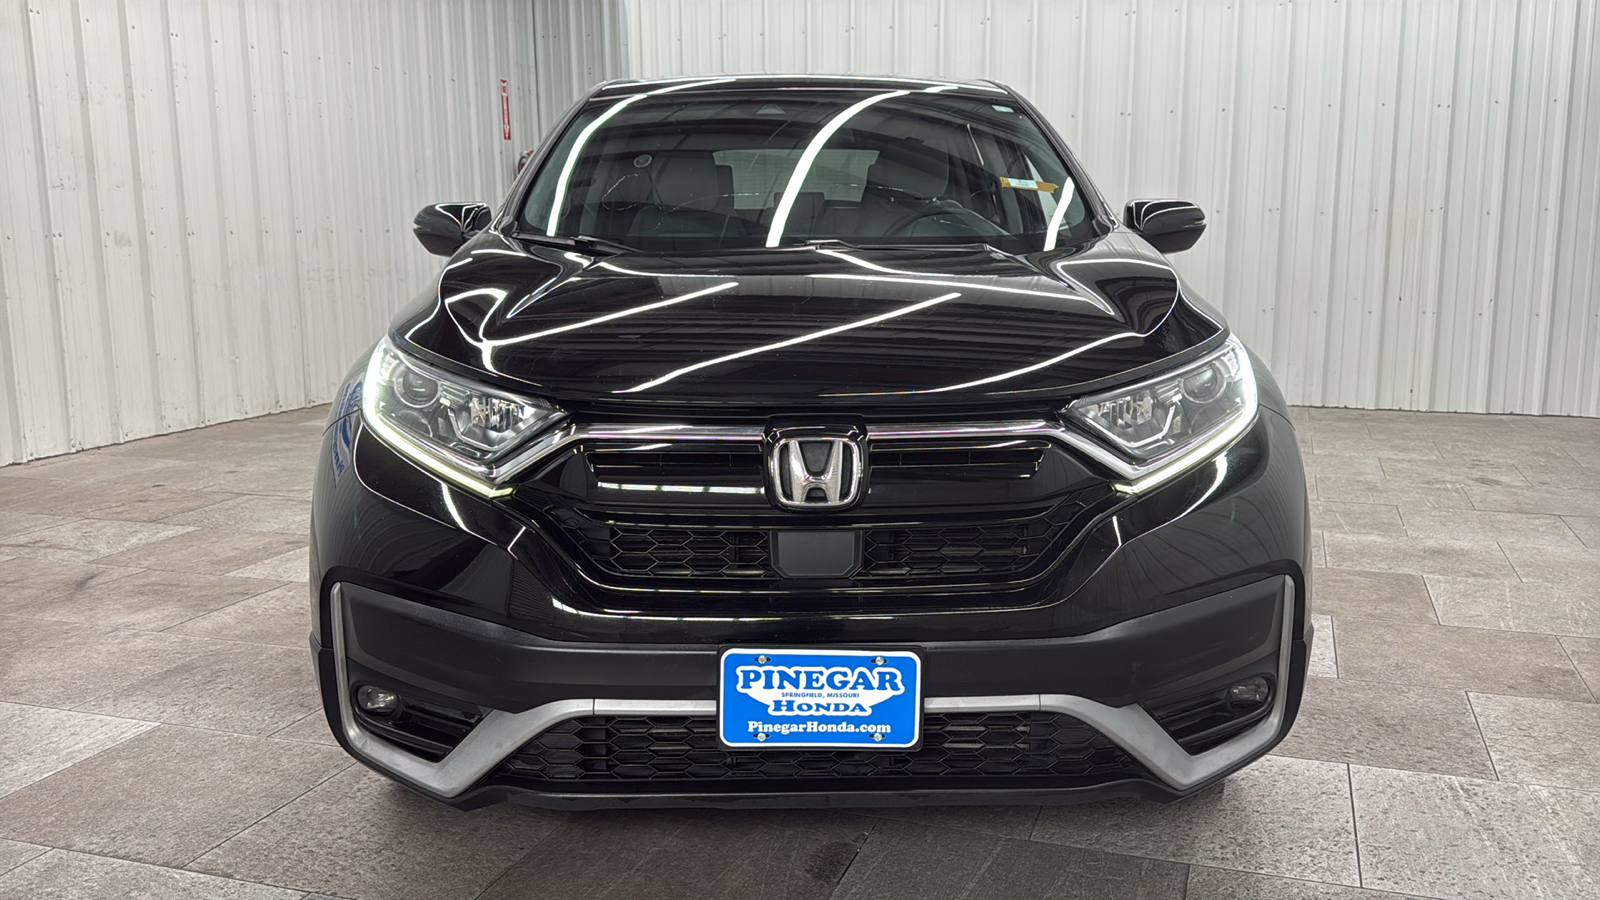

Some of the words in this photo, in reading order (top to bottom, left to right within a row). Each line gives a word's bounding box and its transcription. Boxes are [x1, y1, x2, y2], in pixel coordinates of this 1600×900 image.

[786, 438, 845, 505] H
[740, 669, 902, 691] PINEGAR
[772, 699, 868, 712] HONDA
[747, 721, 891, 735] PinegarHonda.com
